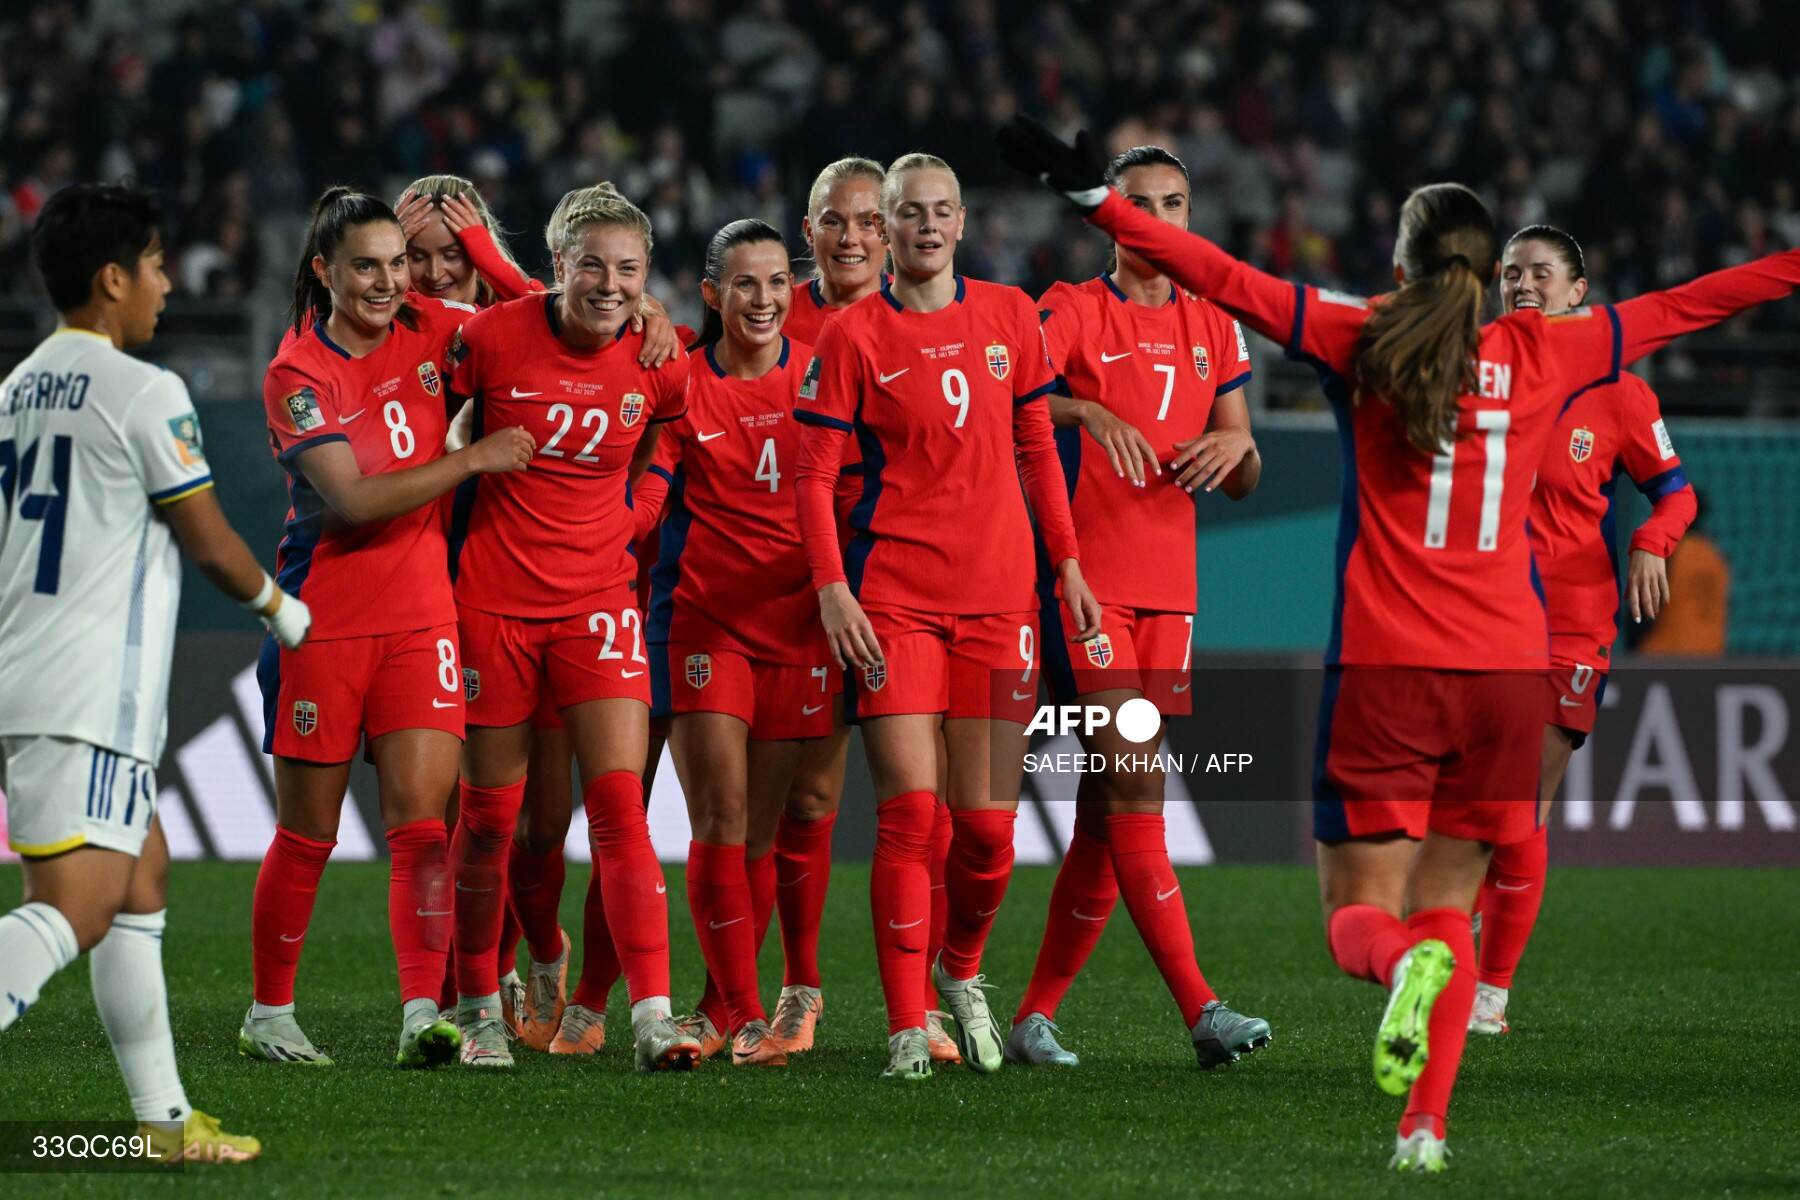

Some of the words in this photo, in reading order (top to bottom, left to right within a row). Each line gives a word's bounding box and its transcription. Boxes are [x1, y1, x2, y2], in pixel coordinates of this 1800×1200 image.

[941, 368, 970, 428] 9
[1153, 363, 1176, 421] 7
[383, 400, 415, 459] 8
[540, 403, 609, 463] 22
[755, 438, 781, 493] 4
[1424, 410, 1511, 552] 11
[588, 607, 647, 665] 22
[1018, 624, 1034, 682] 9
[436, 638, 459, 693] 8
